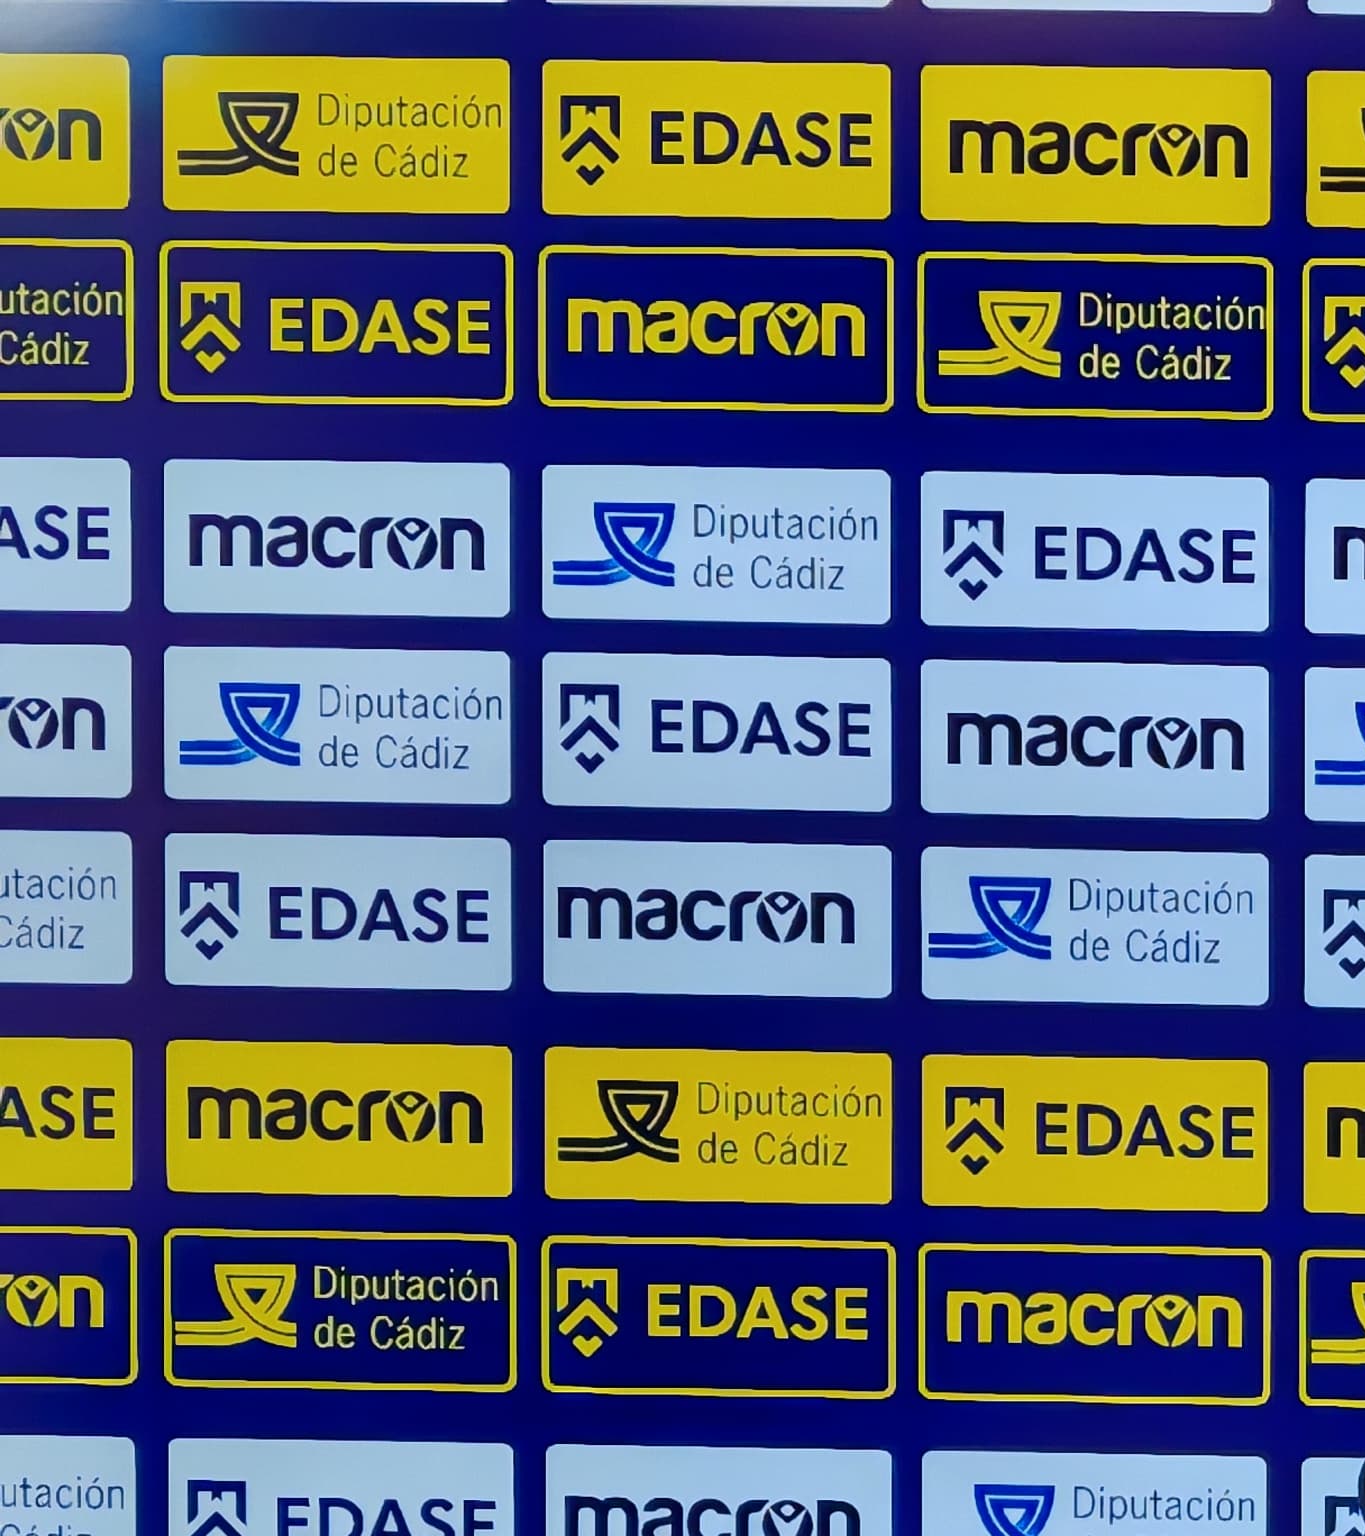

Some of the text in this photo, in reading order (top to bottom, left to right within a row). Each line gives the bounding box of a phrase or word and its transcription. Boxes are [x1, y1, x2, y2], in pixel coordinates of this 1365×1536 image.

[318, 93, 502, 132] Diputación
[650, 110, 873, 168] EDASE
[949, 119, 1249, 179] macron
[318, 143, 469, 179] de Cádiz
[0, 281, 123, 317] utación
[1079, 291, 1265, 335] Diputación
[0, 330, 90, 366] Cádiz
[270, 298, 491, 356] EDASE
[567, 298, 866, 357] macron
[1079, 343, 1232, 381] de Cádiz
[0, 504, 110, 561] ASE
[188, 513, 486, 571] macron
[693, 503, 878, 545] Diputación
[693, 554, 845, 591] de Cádiz
[1034, 526, 1256, 584] EDASE
[319, 683, 502, 724] Diputación
[650, 699, 872, 758] EDASE
[946, 712, 1245, 771] macron
[318, 734, 470, 770] de Cádiz
[268, 886, 489, 944] EDASE
[556, 886, 856, 945] macron
[1069, 878, 1253, 919] Diputación
[0, 914, 85, 950] Cádiz
[1069, 928, 1221, 964] de Cádiz
[0, 1085, 116, 1140] ASE
[187, 1086, 484, 1144] macron
[698, 1081, 882, 1121] Diputación
[697, 1131, 849, 1167] de Cádiz
[1035, 1102, 1255, 1159] EDASE
[313, 1265, 499, 1306] Diputación
[313, 1315, 466, 1351] de Cádiz
[647, 1283, 869, 1341] EDASE
[946, 1290, 1243, 1348] macron
[1, 1475, 125, 1510] utación
[1073, 1485, 1255, 1525] Diputación
